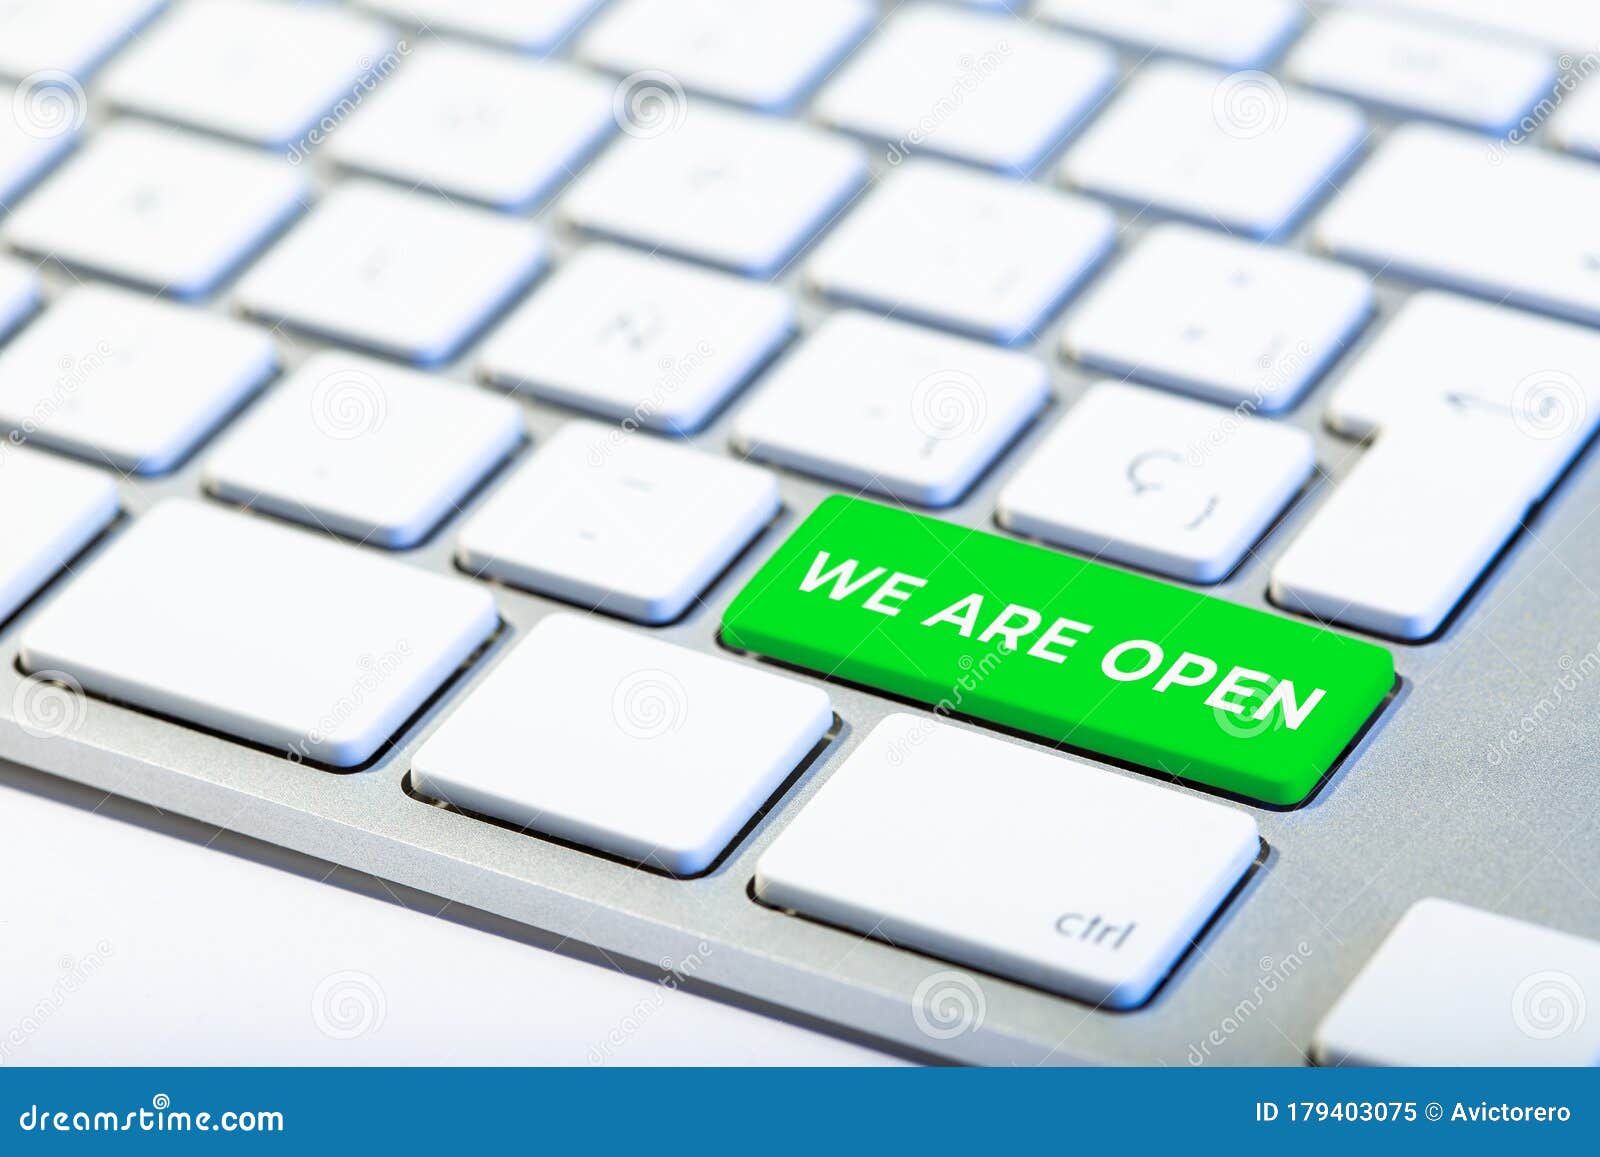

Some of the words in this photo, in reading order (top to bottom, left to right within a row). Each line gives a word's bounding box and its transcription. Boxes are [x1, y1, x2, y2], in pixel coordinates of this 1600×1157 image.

[799, 550, 928, 616] WE
[921, 593, 1094, 664] ARE
[1101, 639, 1327, 731] OPEN
[1054, 912, 1136, 951] ctrl
